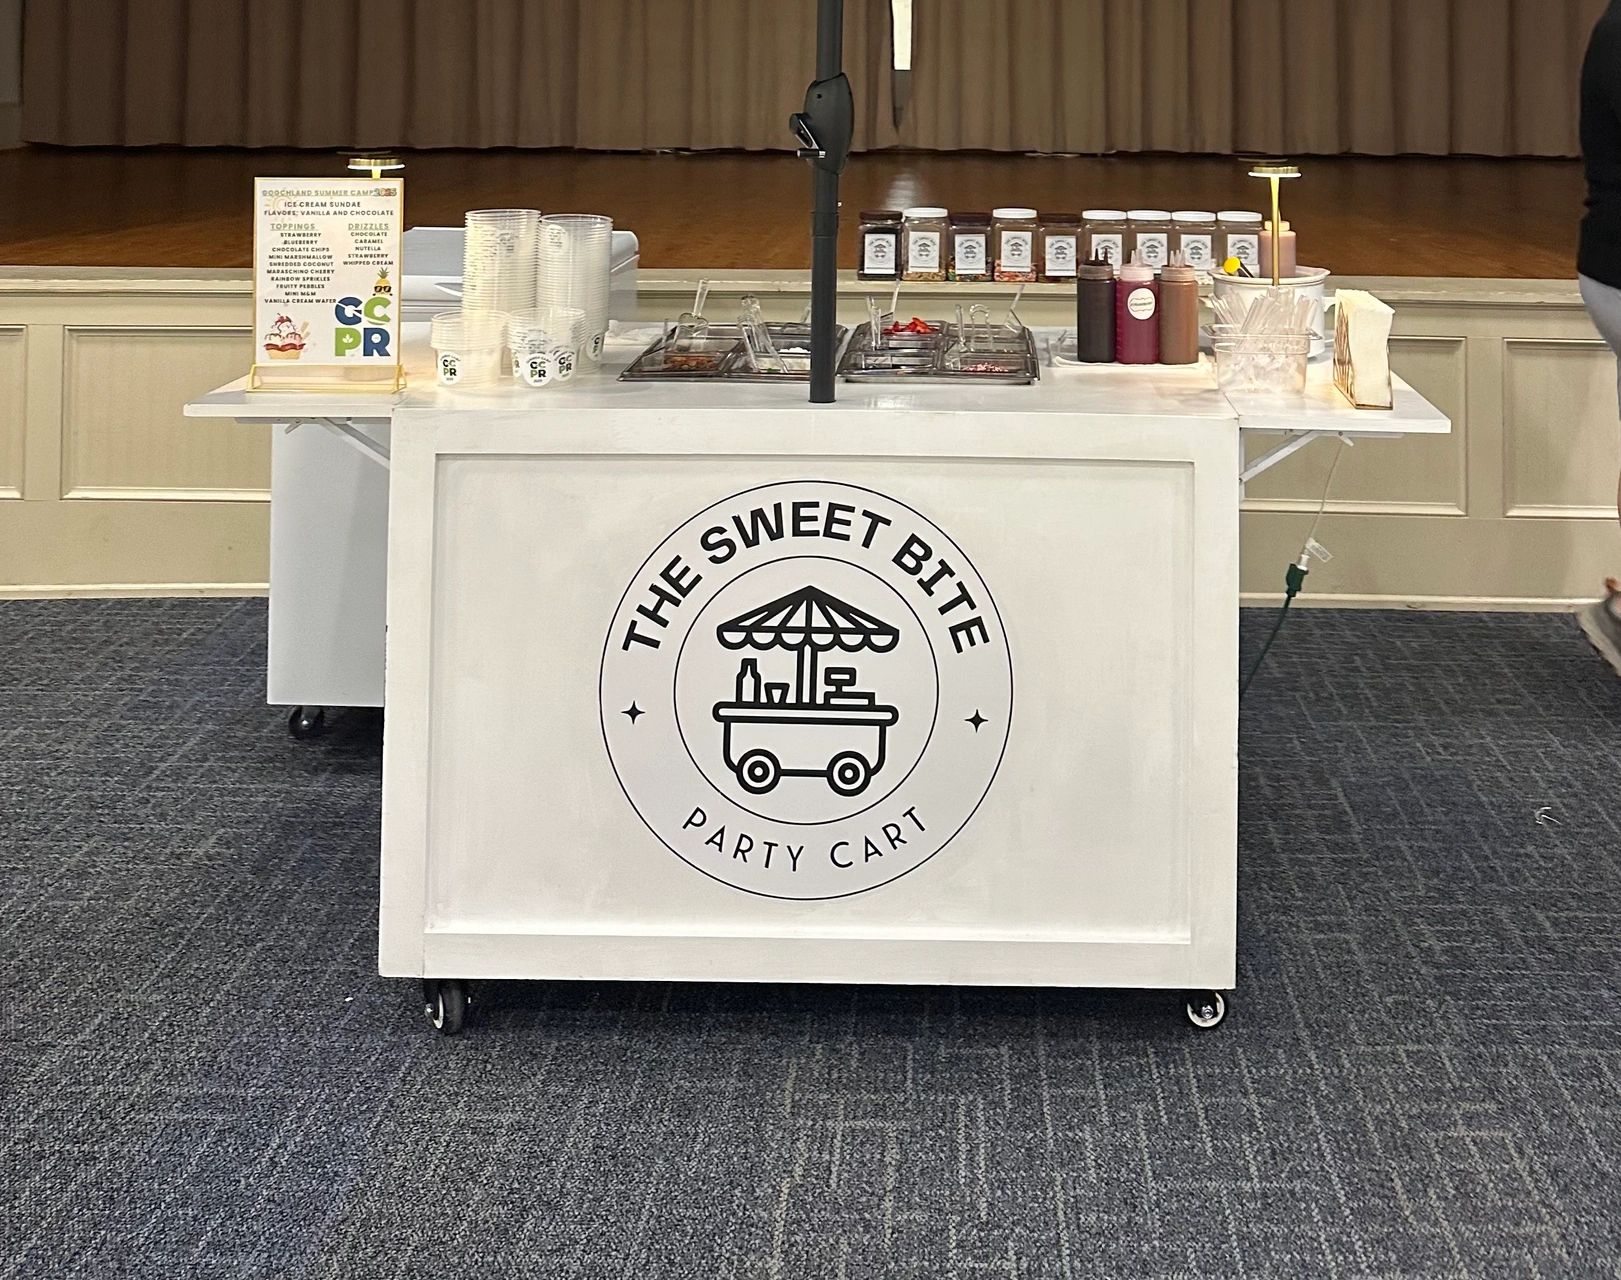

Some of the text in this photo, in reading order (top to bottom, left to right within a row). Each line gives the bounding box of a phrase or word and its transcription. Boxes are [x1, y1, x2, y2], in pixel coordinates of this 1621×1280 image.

[262, 189, 312, 197] GOOCHLAND
[314, 189, 349, 197] SUMMER
[350, 189, 374, 197] CAMP
[270, 223, 316, 231] TOPPINGS
[334, 327, 391, 357] PR
[442, 367, 457, 377] PR
[530, 369, 547, 378] PR
[621, 500, 991, 654] THE SWEET BITE
[682, 805, 928, 872] PARTY CART
